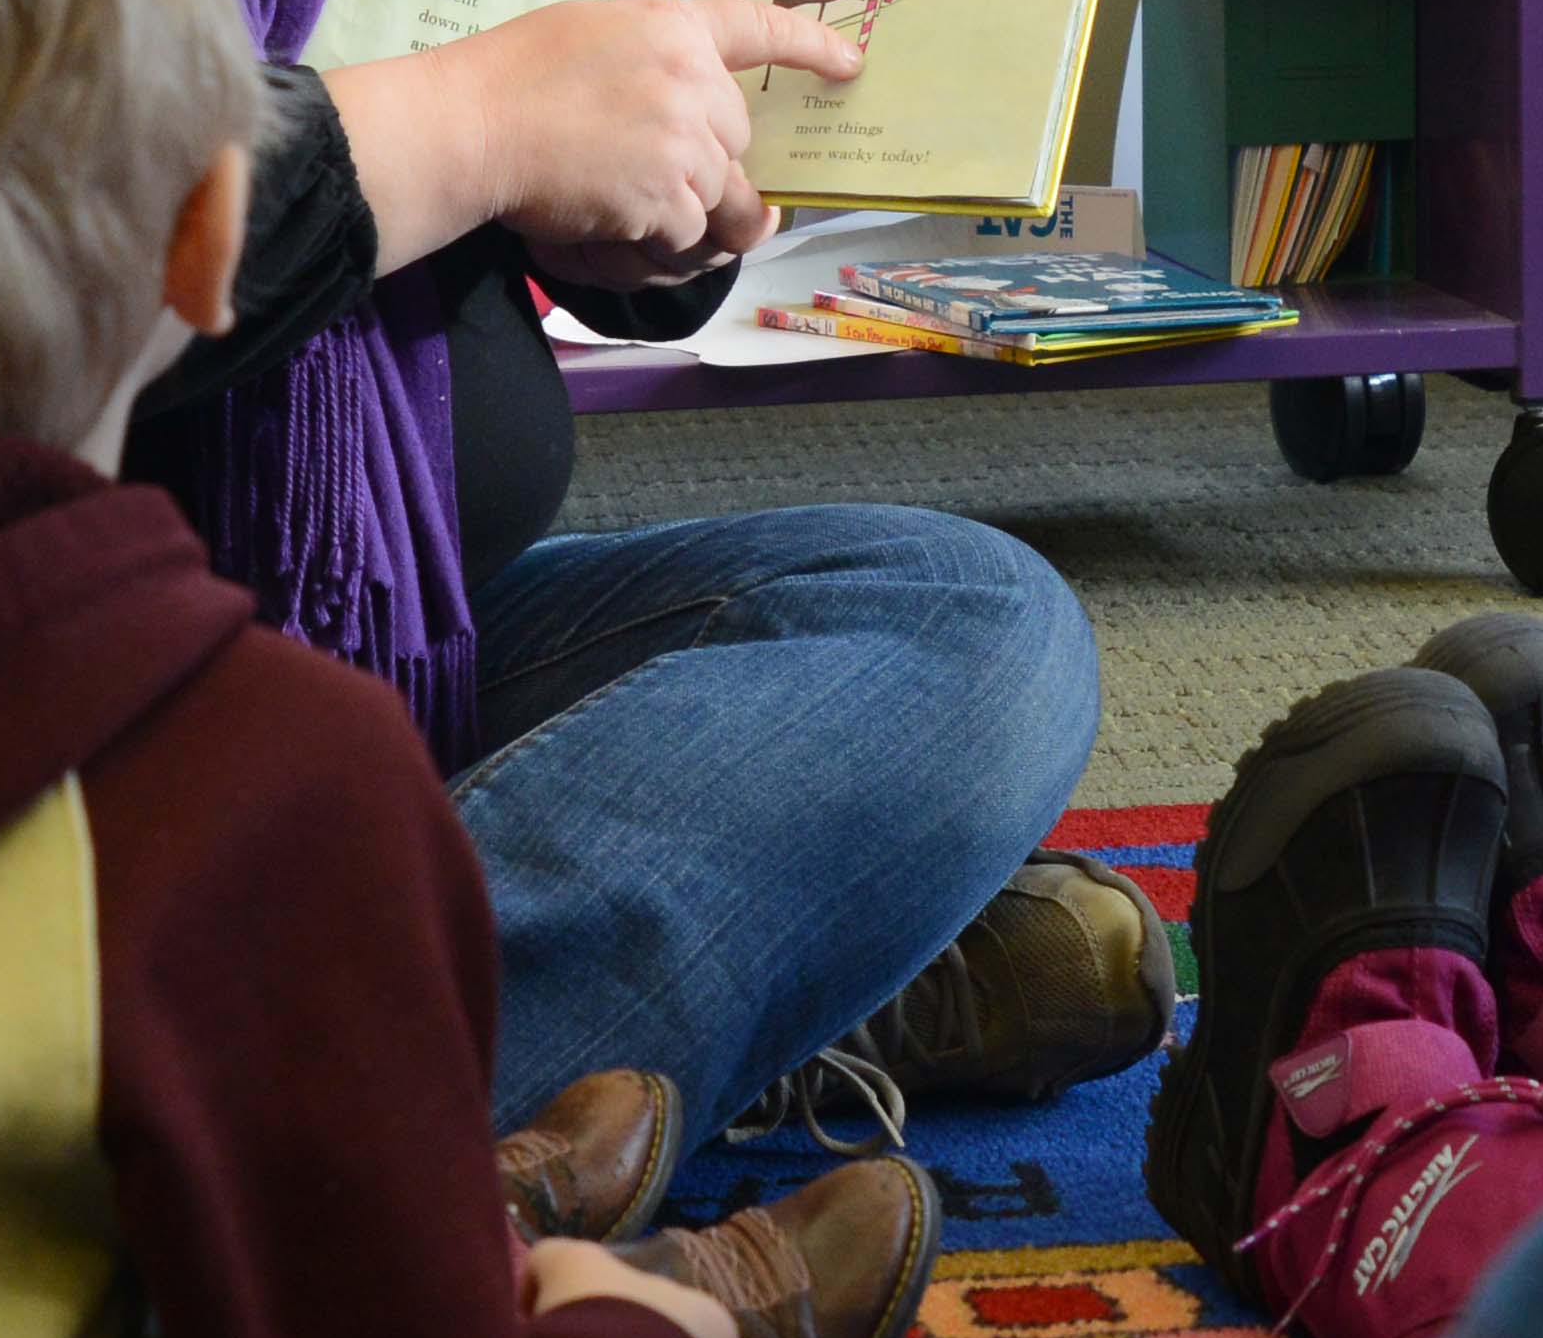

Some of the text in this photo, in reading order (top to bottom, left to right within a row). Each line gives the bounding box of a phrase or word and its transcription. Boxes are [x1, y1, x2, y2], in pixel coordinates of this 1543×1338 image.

[418, 9, 460, 32] down
[802, 95, 845, 109] Three
[795, 121, 884, 136] more things
[789, 148, 931, 165] were wacky today!
[1059, 196, 1074, 239] THE
[1353, 1144, 1454, 1296] ARCTIC CAT
